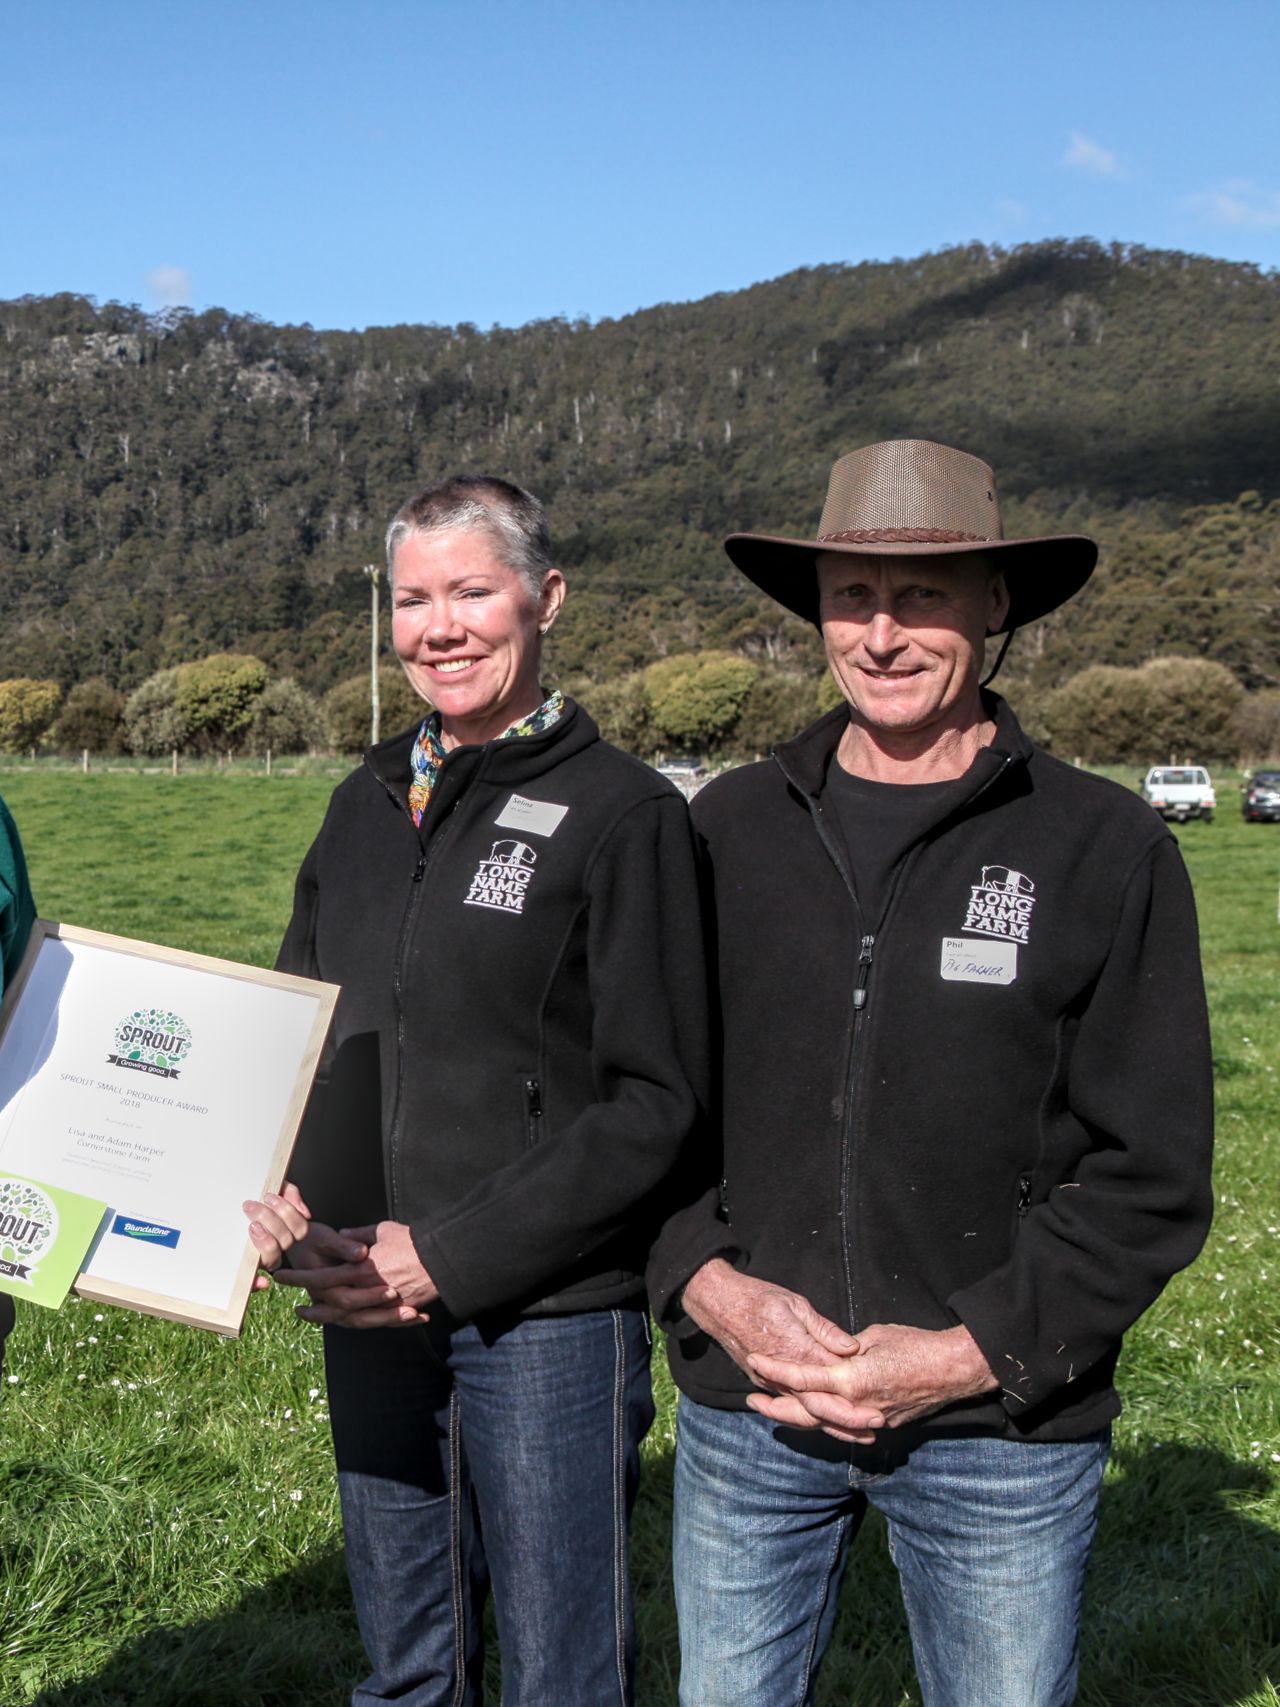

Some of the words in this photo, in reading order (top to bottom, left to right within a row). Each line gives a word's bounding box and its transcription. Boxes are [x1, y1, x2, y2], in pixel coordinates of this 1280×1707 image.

[476, 864, 531, 883] LONG
[470, 875, 528, 896] NAME
[466, 887, 525, 910] FARM
[970, 889, 1033, 912] LONG
[967, 902, 1031, 926] NAME
[964, 914, 1029, 940] FARM
[946, 940, 963, 949] Phil
[120, 1025, 187, 1054] SPROUT
[120, 1059, 148, 1071] Growing
[147, 1066, 166, 1076] good.
[60, 1072, 94, 1087] SPROUT
[97, 1081, 123, 1095] SMALL
[126, 1088, 174, 1107] PRODUCER
[175, 1101, 209, 1115] AWARD
[119, 1097, 141, 1109] 2018
[107, 1136, 132, 1149] Adam
